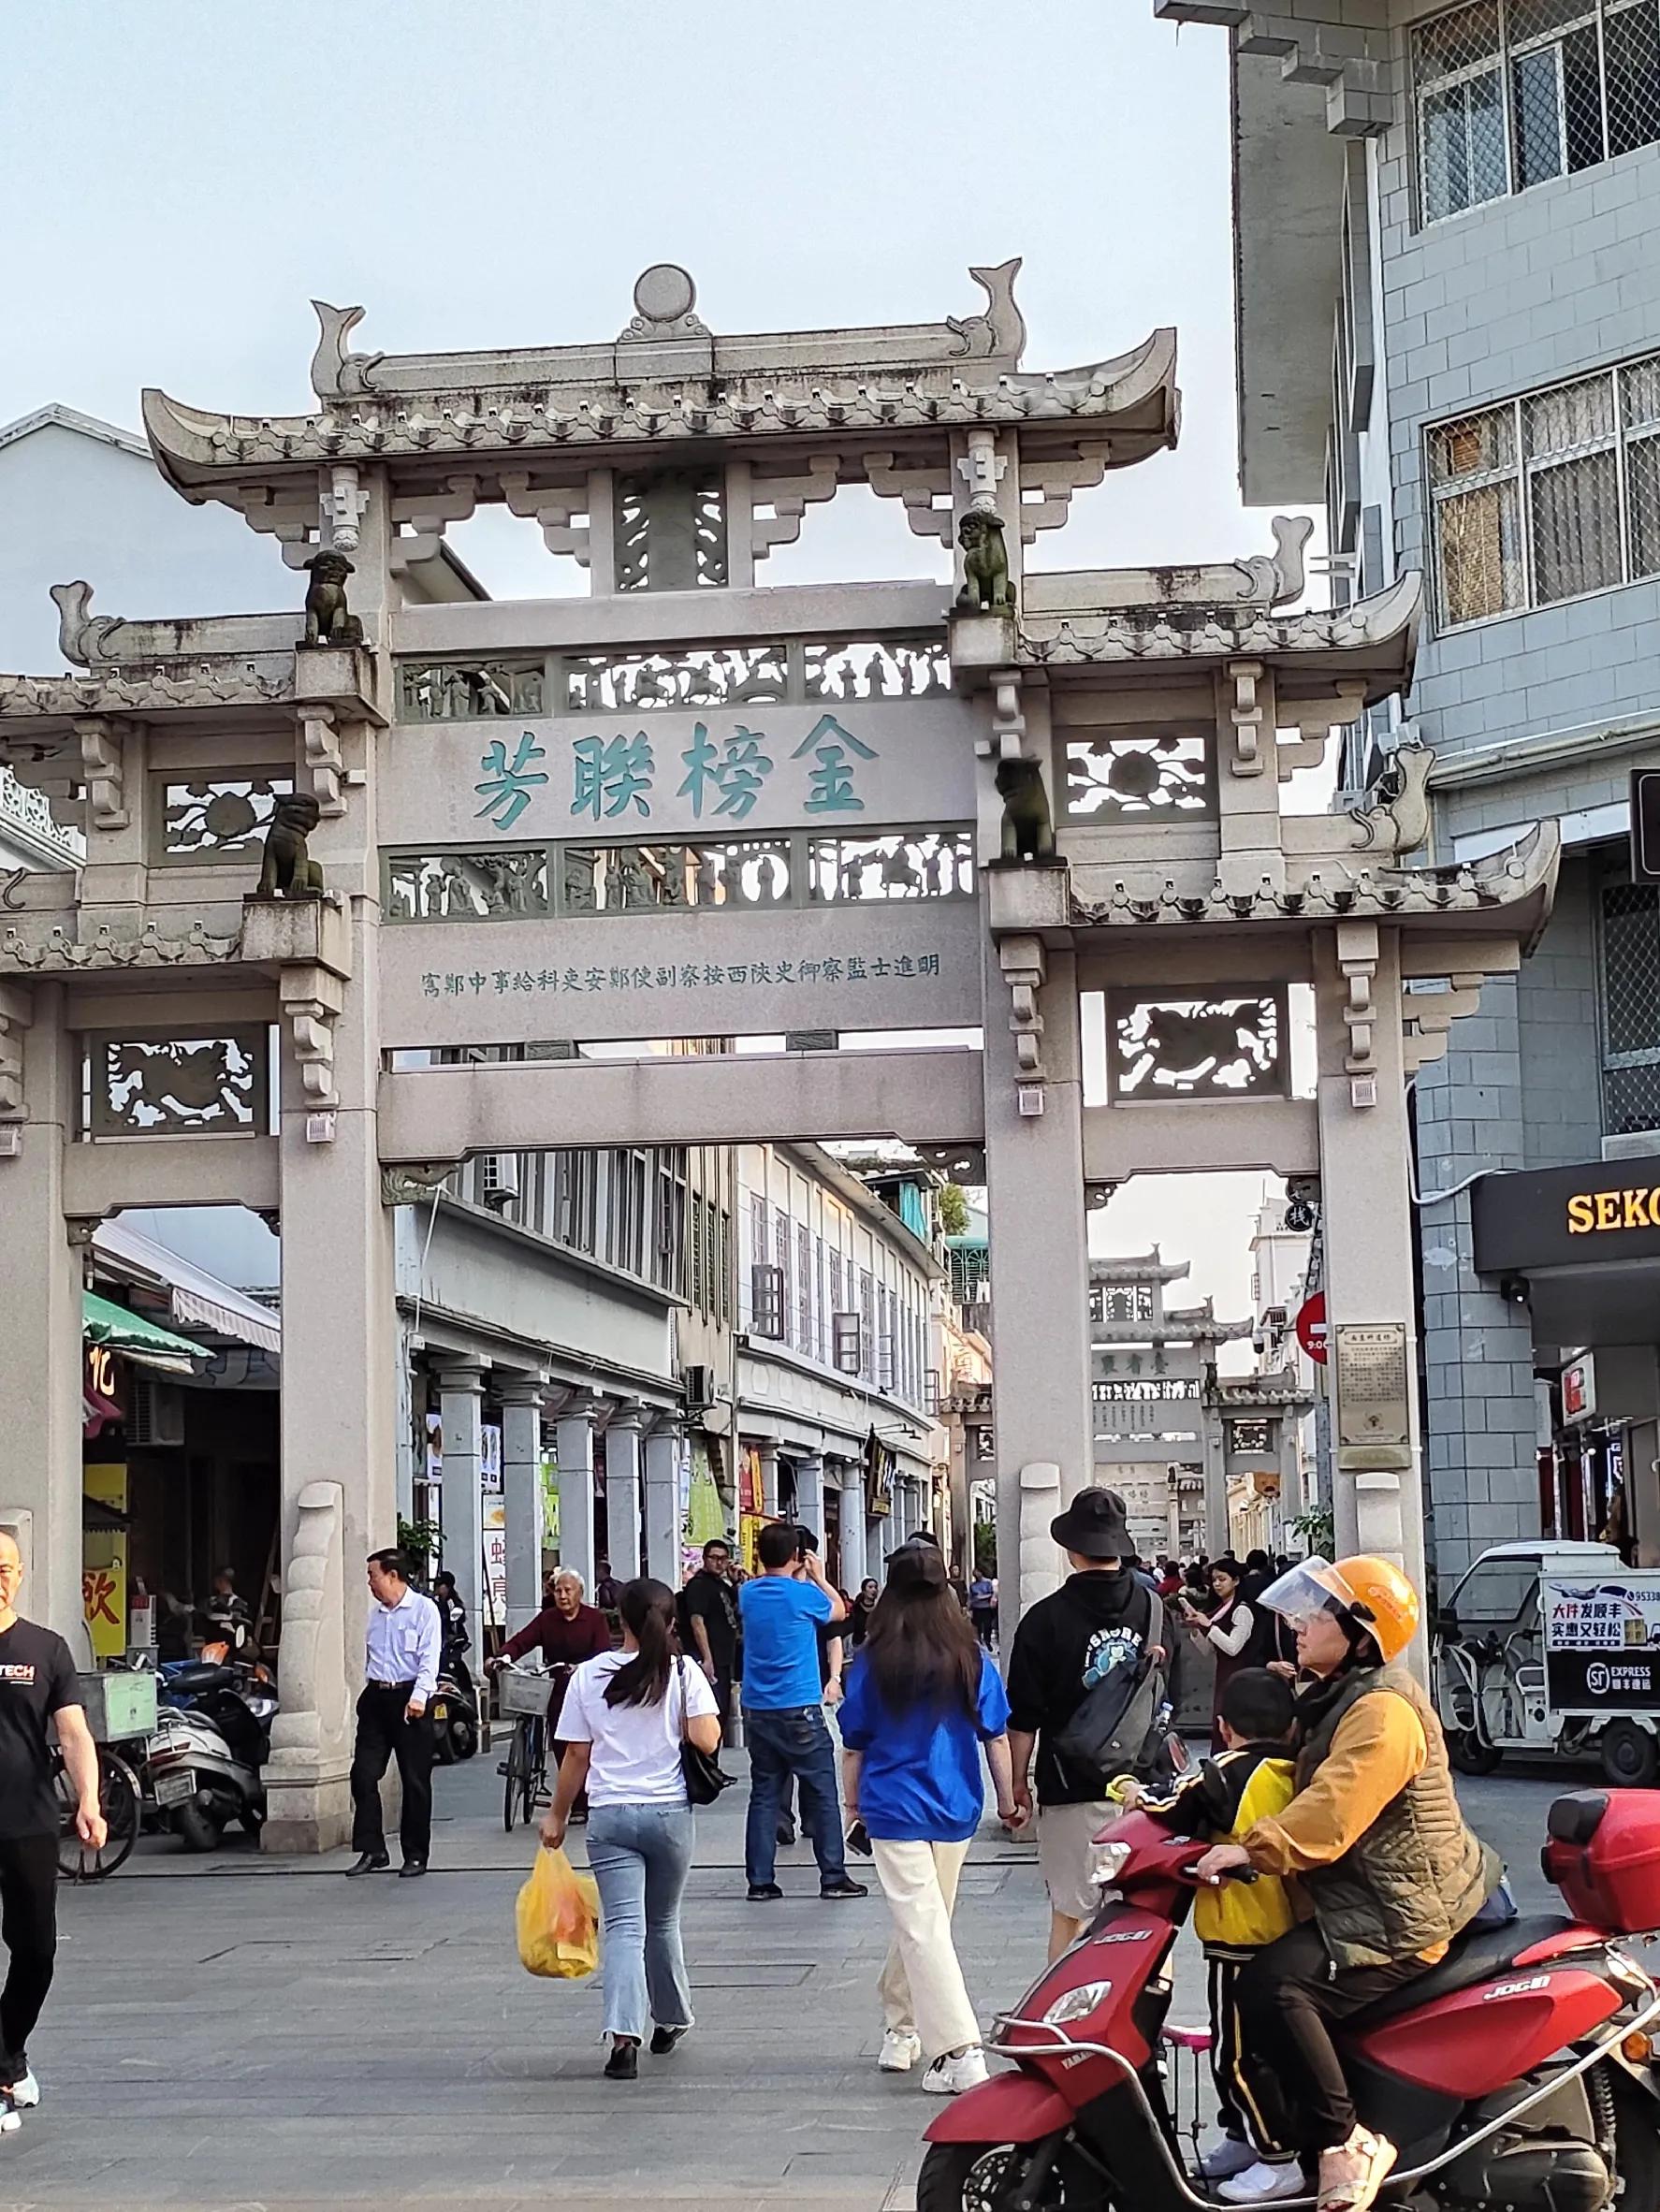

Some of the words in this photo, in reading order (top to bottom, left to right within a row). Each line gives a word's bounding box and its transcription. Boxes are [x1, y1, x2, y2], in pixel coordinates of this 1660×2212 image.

[1552, 1603, 1622, 1618] 大件发顺丰
[1552, 1622, 1621, 1637] 实惠又轻松
[1611, 1666, 1651, 1677] EXPRESS
